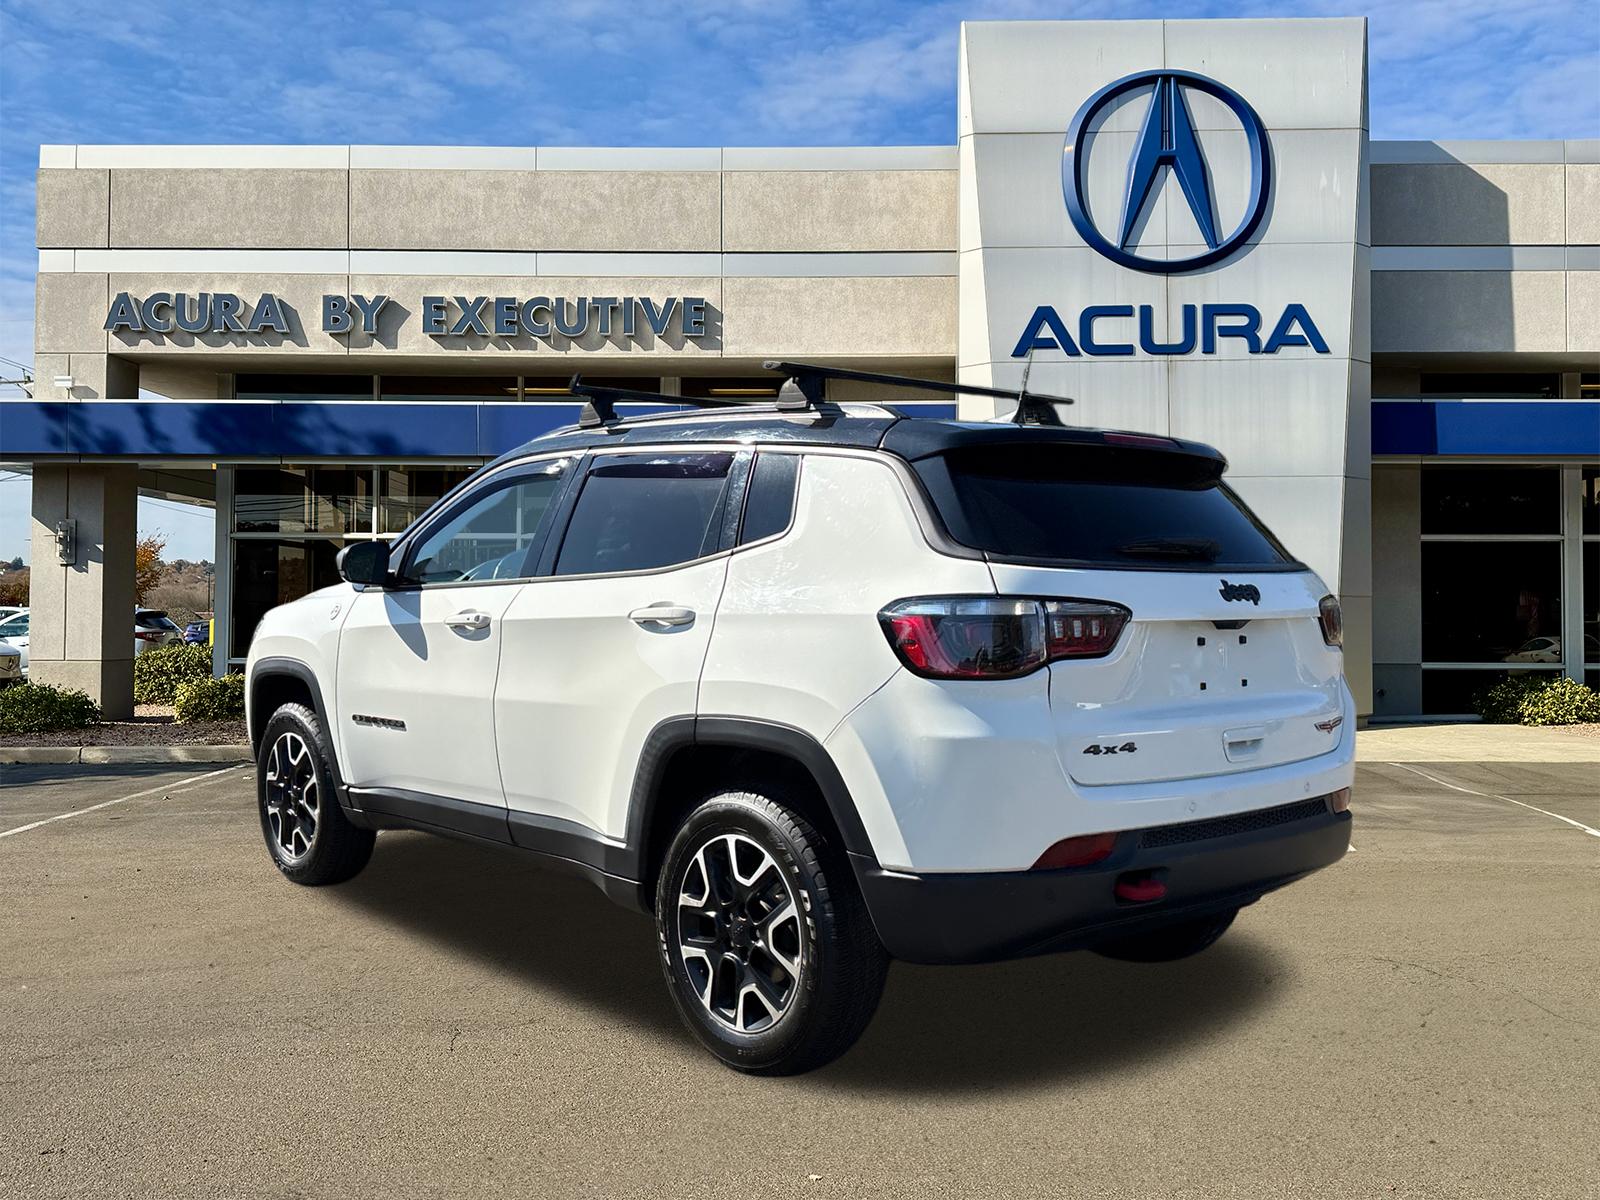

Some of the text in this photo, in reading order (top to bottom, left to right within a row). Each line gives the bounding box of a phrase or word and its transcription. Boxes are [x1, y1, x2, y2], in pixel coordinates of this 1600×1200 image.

[103, 291, 706, 337] ACURA BY EXECUTIVE
[1010, 303, 1333, 358] ACURA
[1218, 579, 1261, 606] Jeep
[1082, 741, 1138, 756] 4x4
